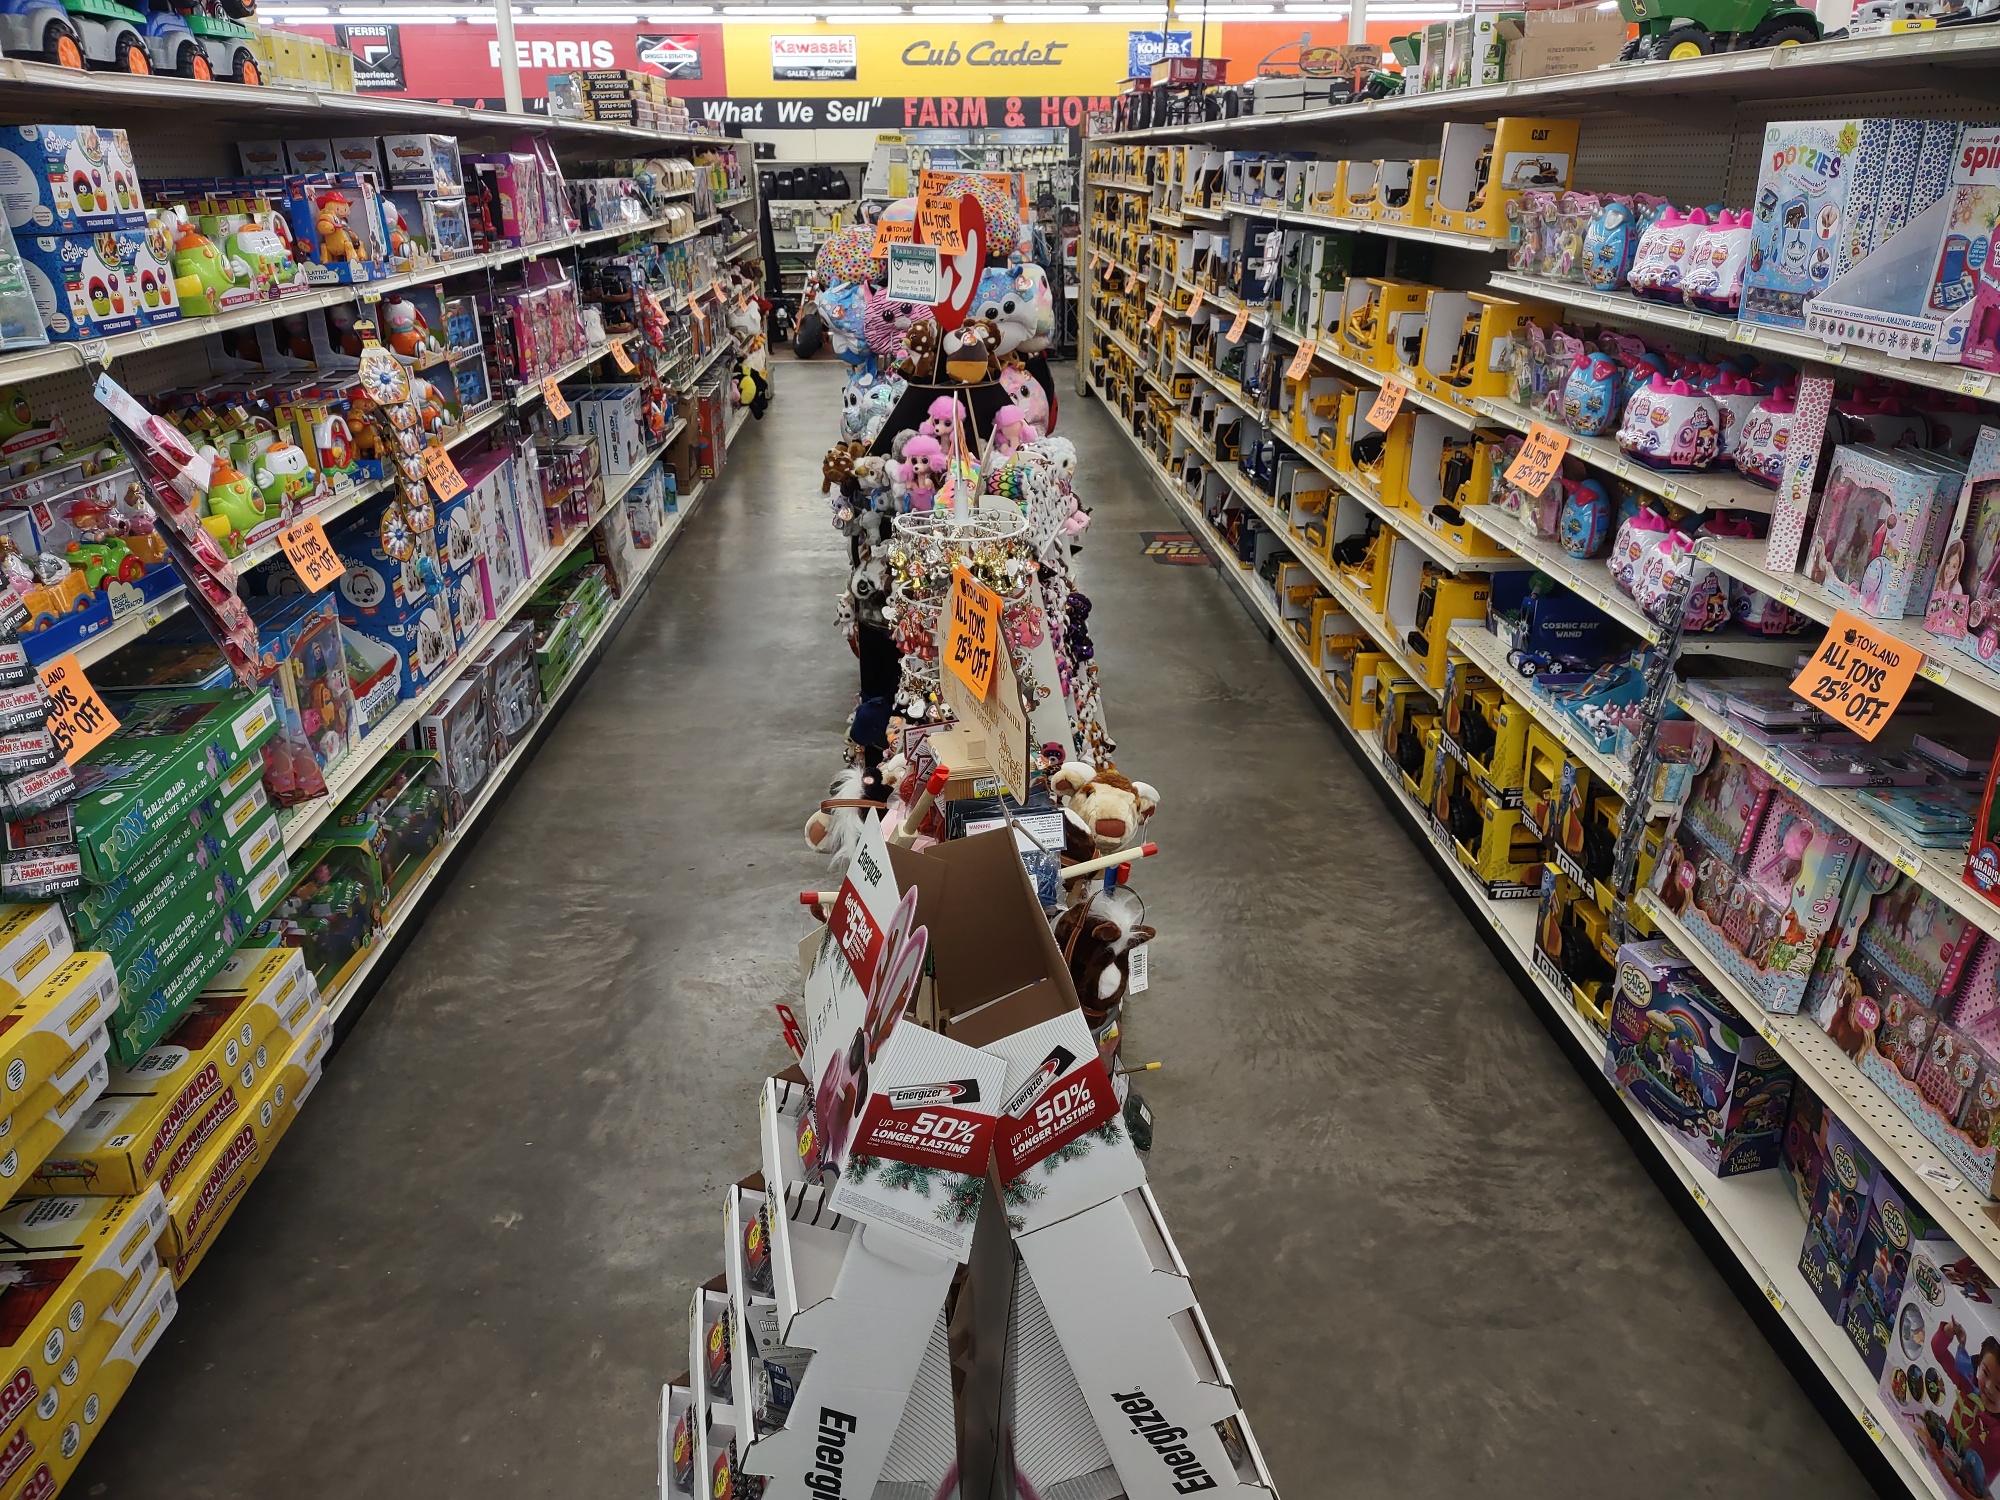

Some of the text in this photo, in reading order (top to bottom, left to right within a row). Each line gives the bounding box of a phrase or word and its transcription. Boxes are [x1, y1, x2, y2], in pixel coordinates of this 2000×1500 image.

[348, 26, 386, 36] FERRIS
[774, 40, 853, 54] Kawasaki
[901, 41, 1069, 66] Cub Cadet
[354, 71, 394, 80] Experience
[354, 79, 396, 87] Suspension
[786, 70, 845, 78] SALES SERVICE
[702, 101, 762, 123] What
[778, 102, 814, 123] We
[904, 97, 1025, 127] FARM &
[44, 132, 72, 154] Giggles
[1530, 129, 1550, 141] CAT
[1773, 145, 1842, 178] DOTZIES
[922, 180, 934, 190] ALL
[930, 200, 952, 210] TOYLAND
[922, 211, 951, 229] ALL TOYS
[878, 234, 891, 244] ALL
[931, 230, 960, 247] 25% OFF
[60, 242, 88, 264] Giggles
[103, 322, 120, 330] STACKING
[1517, 316, 1535, 326] CAT
[1819, 304, 1936, 332] classic way create countless AMAZING DESIGNS!
[1522, 442, 1552, 468] ALL TOYS
[1528, 470, 1550, 489] OFF
[292, 522, 314, 540] TOYLAND
[288, 535, 321, 566] ALL TOYS
[319, 547, 336, 572] OFF
[4, 608, 28, 630] gift card
[955, 595, 986, 643] ALL TOYS
[1542, 622, 1600, 630] COSMIC RAY
[1556, 630, 1583, 638] WAND
[1981, 636, 1994, 651] 114
[954, 634, 991, 682] 25% OFF
[1856, 635, 1900, 668] TOYLAND
[6, 669, 24, 679] card
[1819, 642, 1887, 693] ALL TOYS
[14, 692, 36, 705] HOME
[50, 684, 78, 722] OYS
[360, 692, 381, 712] Wooden
[1810, 676, 1890, 726] 25% OFF
[10, 710, 44, 725] gift card
[74, 696, 104, 734] OFF
[20, 739, 42, 750] HOME
[1441, 729, 1468, 771] Tonka
[15, 756, 46, 769] gift card
[25, 767, 69, 794] FARM HOME
[50, 782, 76, 802] gift card
[143, 778, 186, 820] TABLE CHAIRS
[152, 813, 168, 832] TABLE
[1522, 812, 1544, 840] Tonka
[100, 798, 146, 872] PONY
[21, 869, 44, 879] FARM
[53, 862, 78, 873] HOME
[38, 860, 54, 868] Center
[857, 844, 883, 888] Energizer
[1554, 845, 1595, 900] Tonka
[46, 878, 79, 892] gift card
[1491, 886, 1542, 898] Tonka
[175, 912, 196, 938] CHAIRS
[1535, 947, 1574, 1003] Tonka
[1622, 970, 1650, 995] FAIRY
[1858, 1002, 1877, 1025] 168
[896, 1087, 943, 1102] Energizer
[1010, 1074, 1044, 1113] Energizer
[143, 1060, 219, 1180] BARNYARD
[1010, 1077, 1091, 1146] UP TO 50%
[878, 1112, 982, 1144] UP TO 50%
[1012, 1099, 1096, 1158] LONGER LASTING
[160, 1085, 234, 1197] BARNYARD
[872, 1128, 971, 1155] LONGER LASTING
[186, 1124, 254, 1241] BARNYARD
[1802, 1254, 1822, 1294] Terrace
[1808, 1251, 1824, 1280] Light
[804, 1406, 857, 1500] Energi
[1110, 1388, 1218, 1495] Energizer
